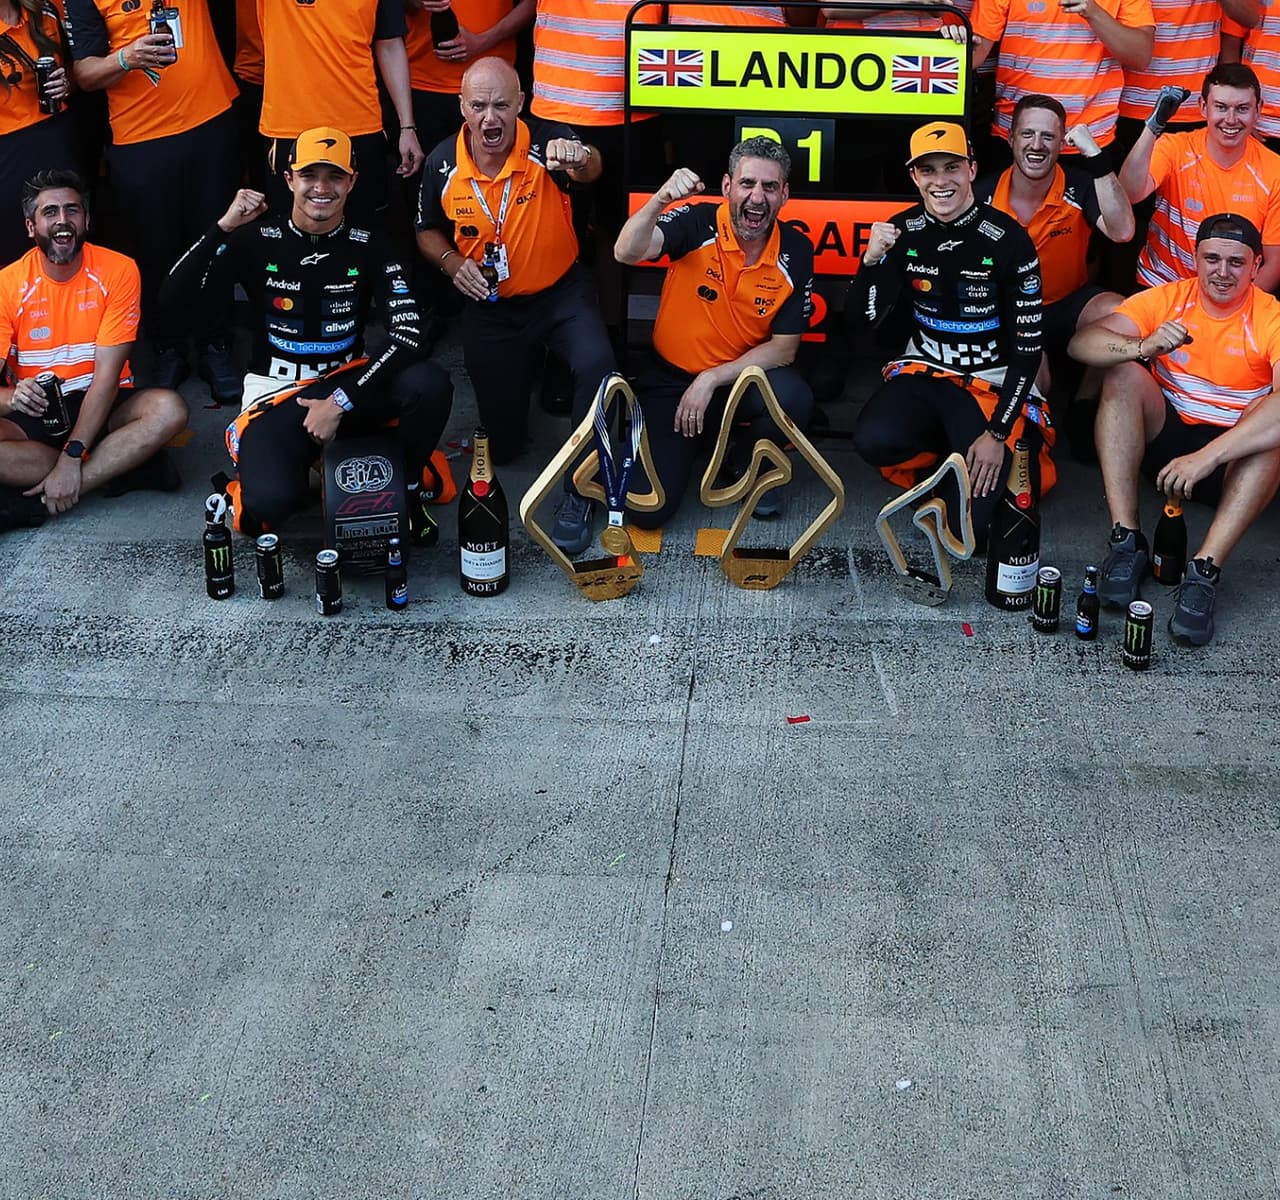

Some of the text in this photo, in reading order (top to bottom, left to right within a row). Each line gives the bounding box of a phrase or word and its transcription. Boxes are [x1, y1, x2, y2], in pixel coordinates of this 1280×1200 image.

[710, 50, 886, 92] LANDO
[906, 263, 939, 276] Android
[265, 277, 301, 291] Android
[324, 319, 355, 333] allwyn
[937, 319, 998, 332] Technologies
[466, 541, 498, 552] MOËT
[467, 582, 499, 593] MOËT
